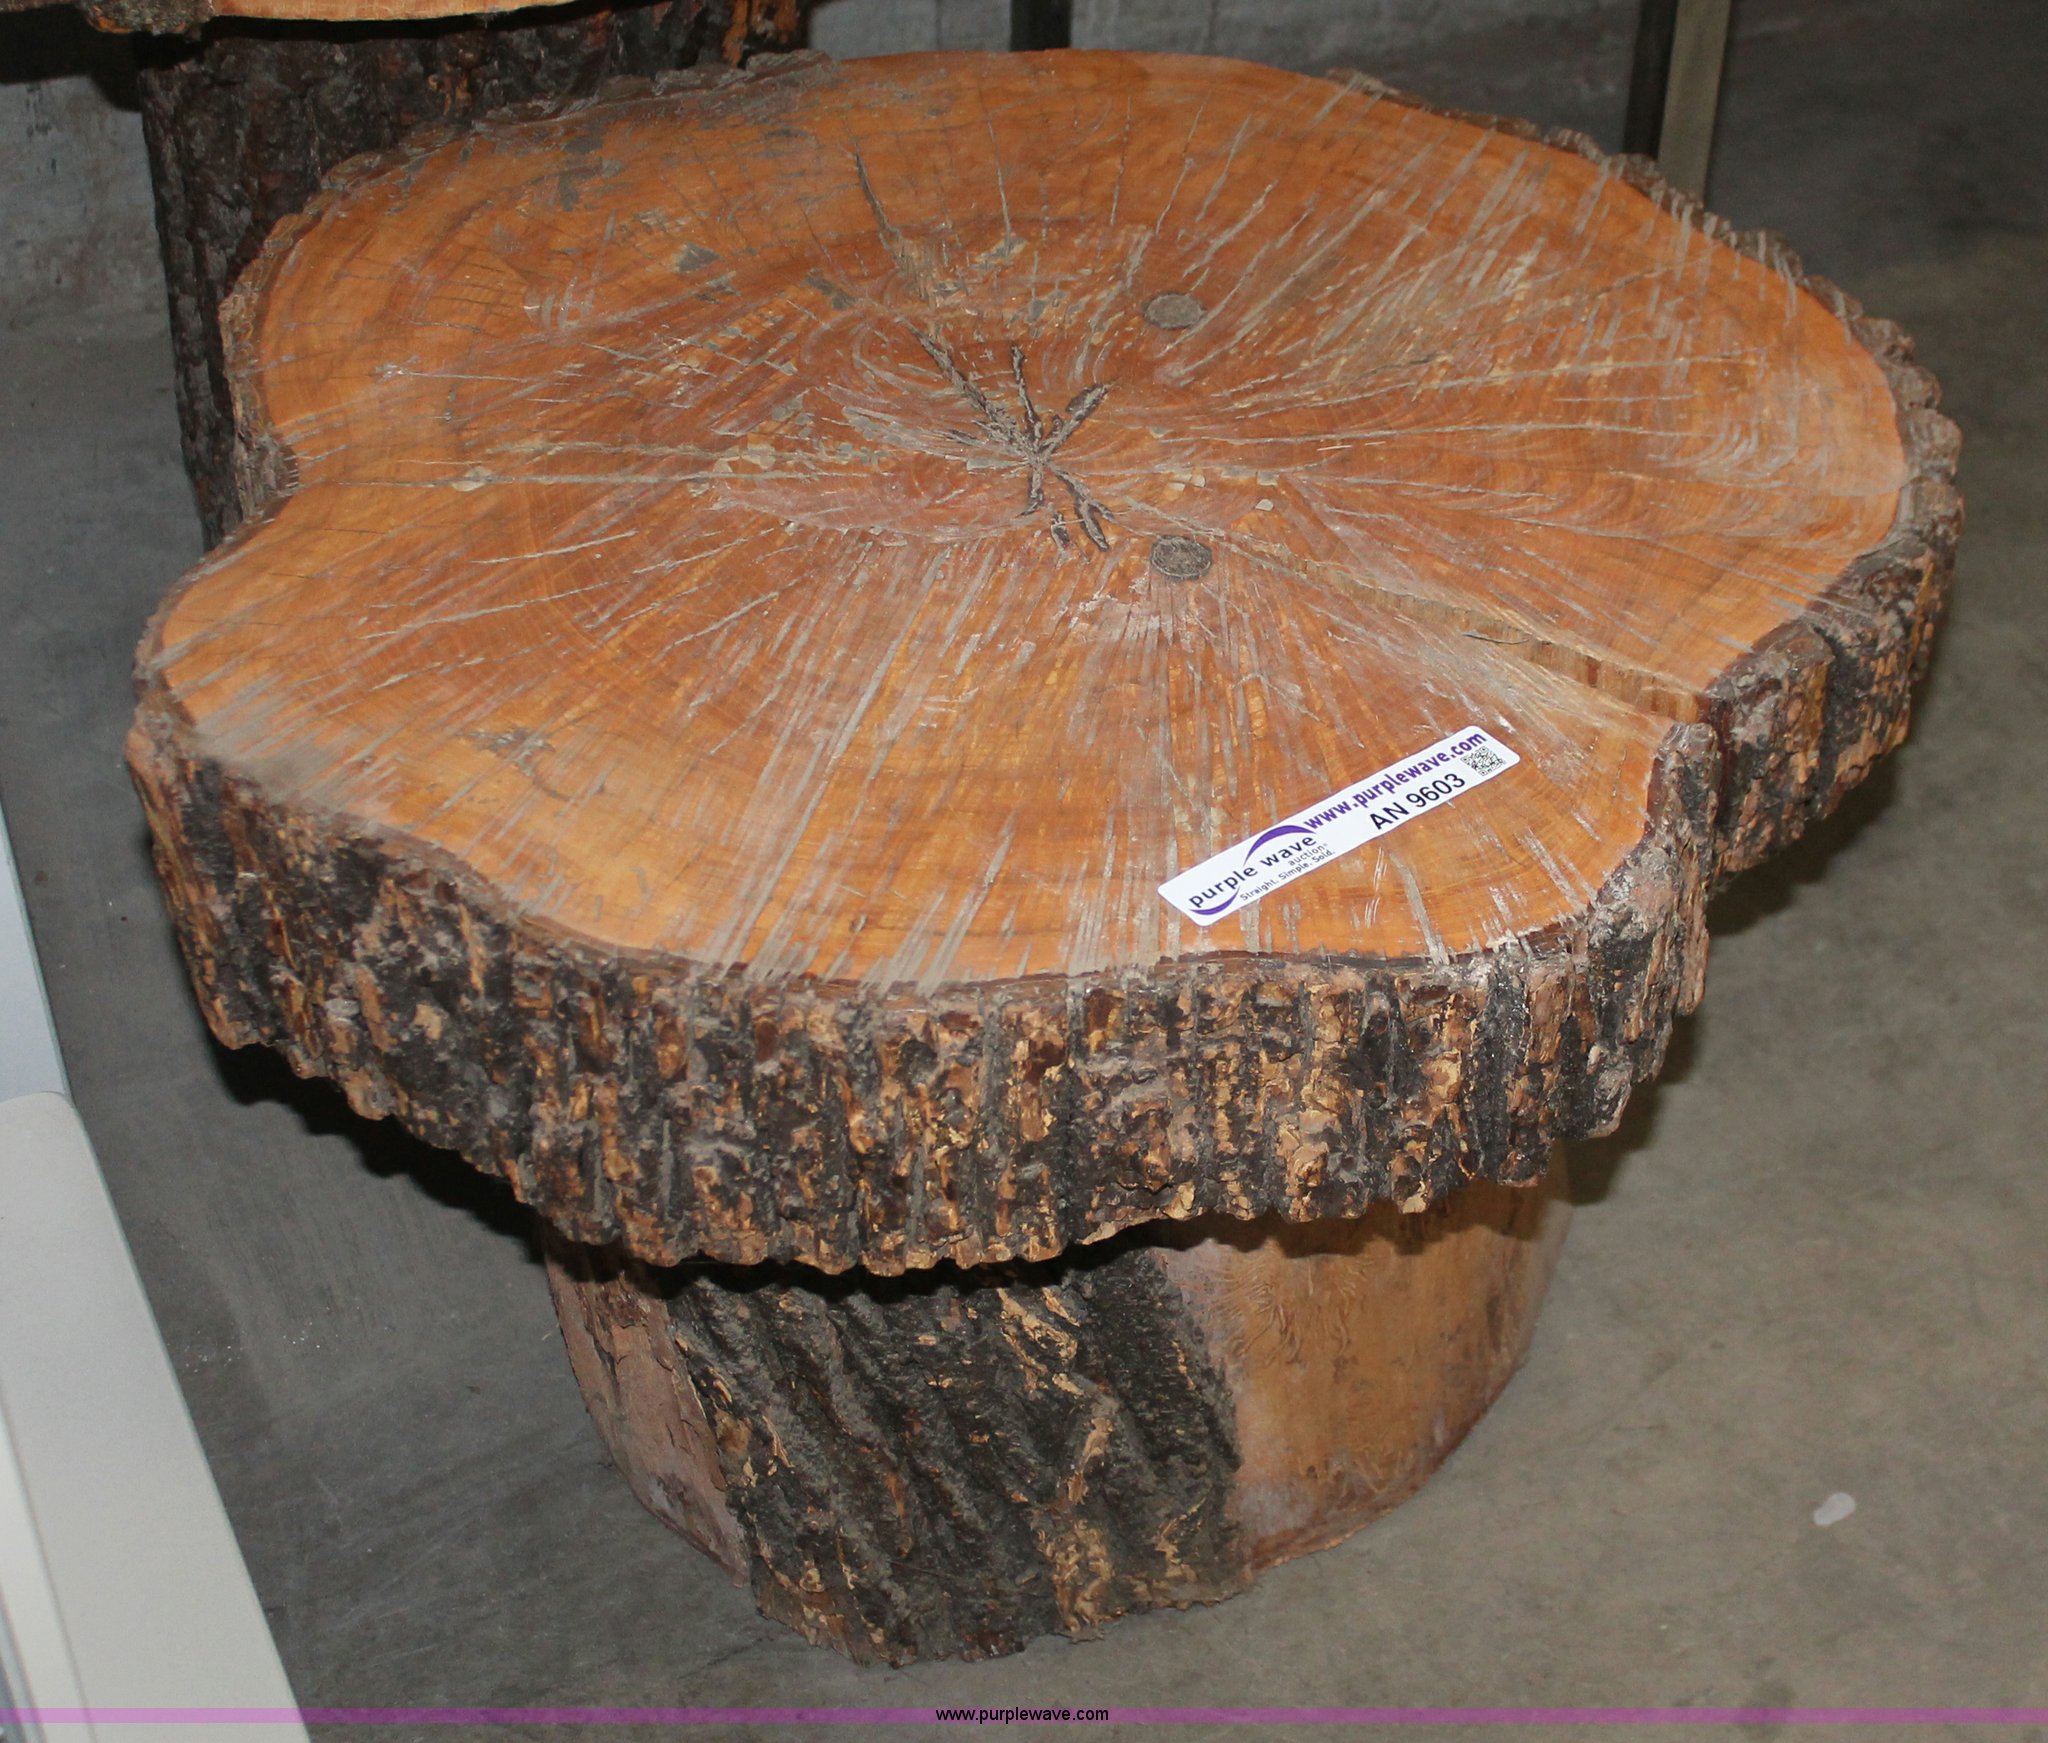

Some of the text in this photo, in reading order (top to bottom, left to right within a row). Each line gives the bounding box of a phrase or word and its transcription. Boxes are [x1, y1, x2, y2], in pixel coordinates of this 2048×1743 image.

[1304, 733, 1487, 829] www.purplewave.com
[1369, 773, 1466, 830] AN 9603
[1188, 836, 1318, 908] purple wave
[1239, 849, 1336, 901] Straight. Simple. Sold.
